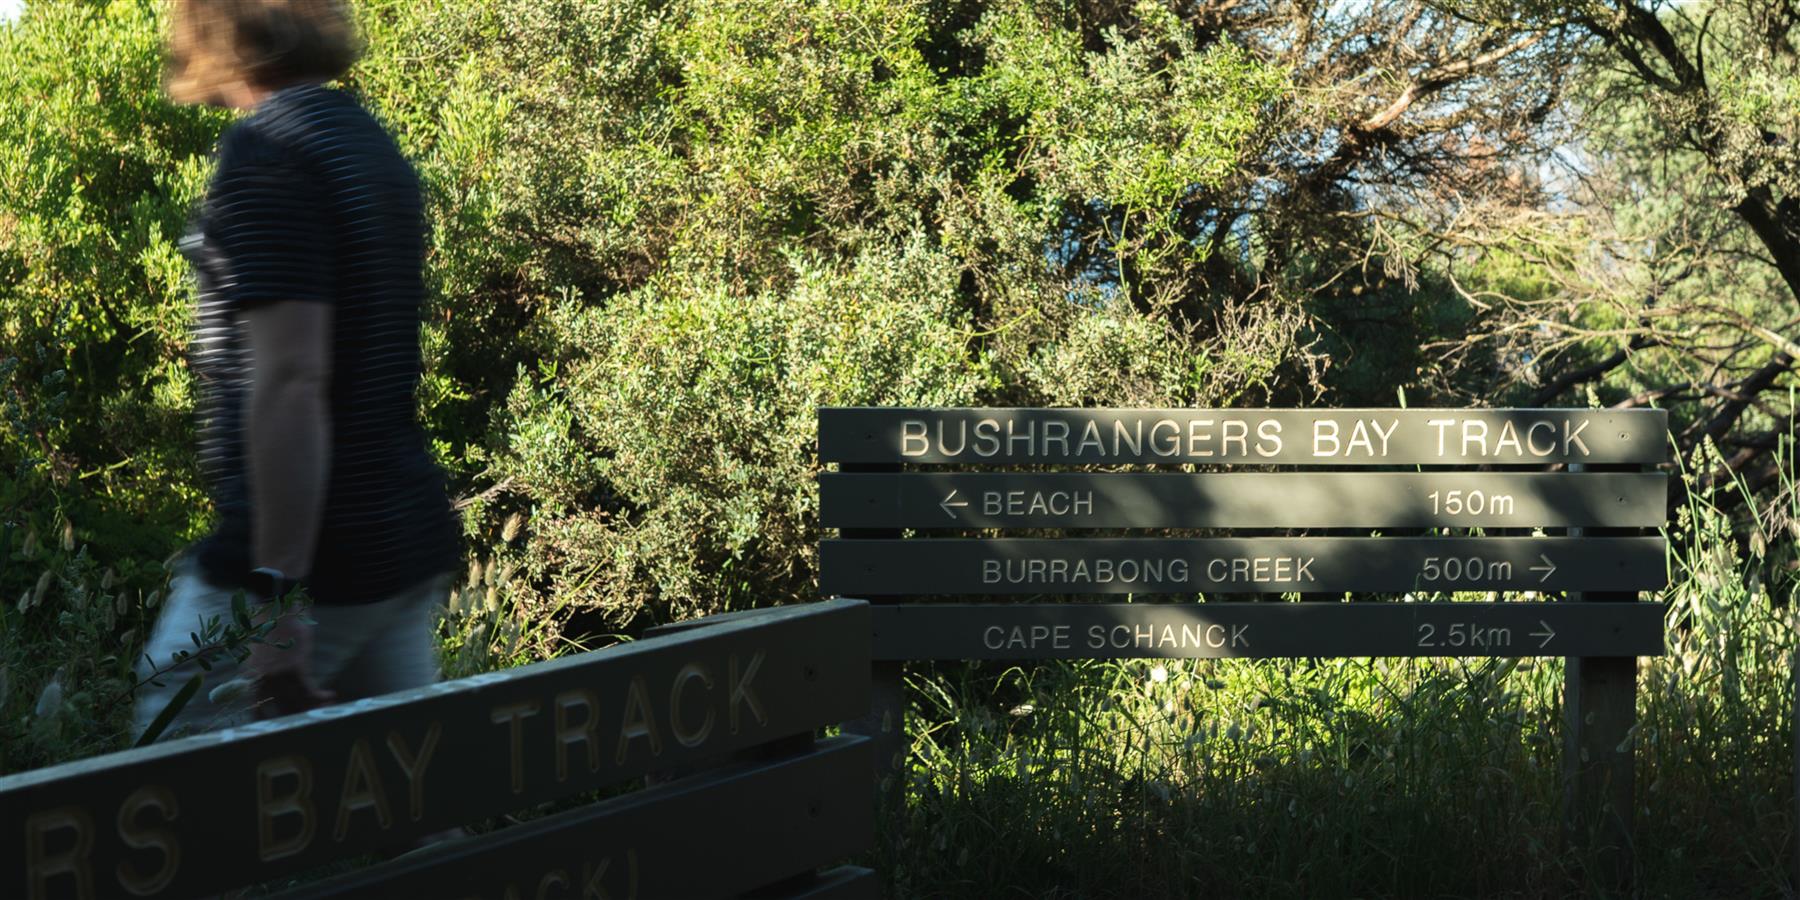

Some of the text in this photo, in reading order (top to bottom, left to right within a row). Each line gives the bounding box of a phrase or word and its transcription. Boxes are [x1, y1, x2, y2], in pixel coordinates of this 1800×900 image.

[900, 418, 1591, 458] BUSHRANGERS BAY TRACK
[983, 489, 1515, 517] BEACH 150m
[982, 556, 1513, 584] BURRABONG CREEK 500m
[983, 622, 1512, 651] CAPE SCHANCK 2.5km
[256, 720, 442, 863] BAY
[490, 648, 768, 794] TRACK
